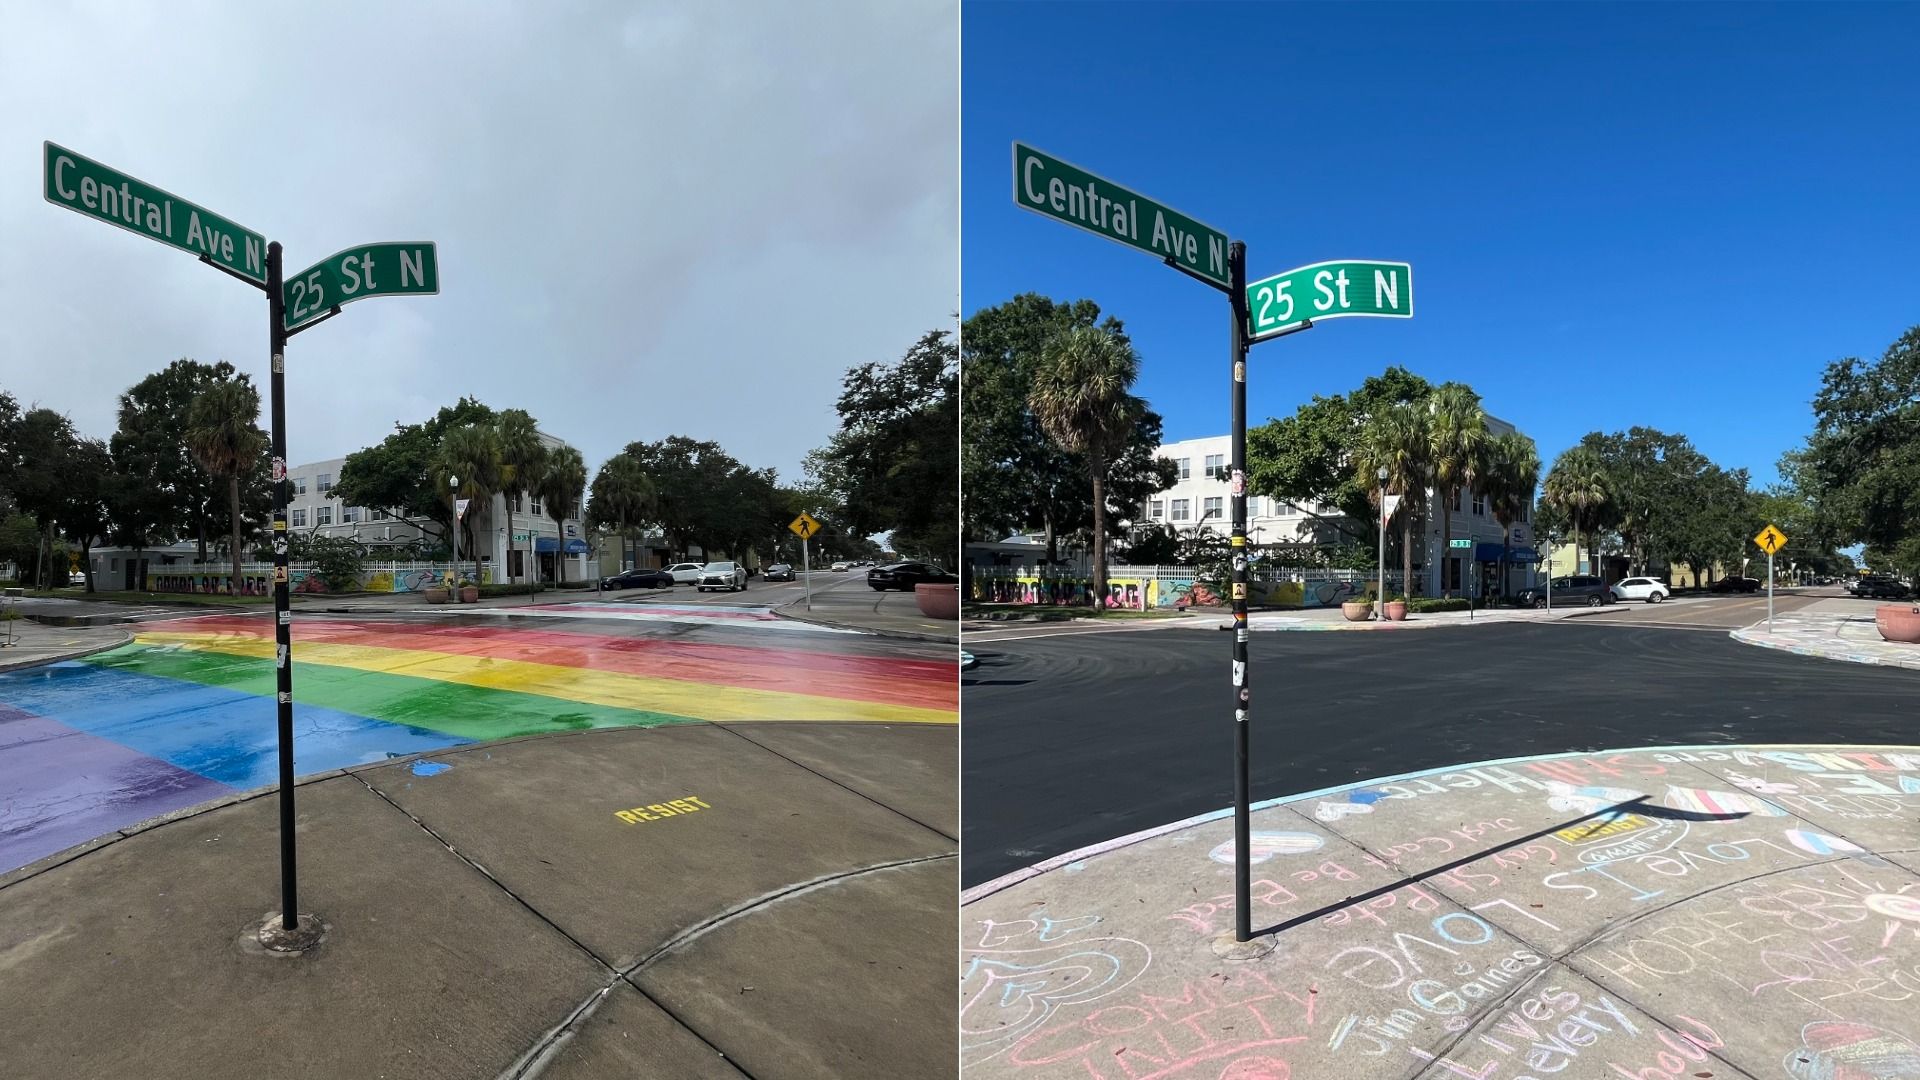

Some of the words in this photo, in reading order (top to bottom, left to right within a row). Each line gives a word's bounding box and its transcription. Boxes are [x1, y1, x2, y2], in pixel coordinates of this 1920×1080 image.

[54, 154, 172, 238] Central
[186, 210, 233, 263] Ave
[244, 235, 260, 274] N
[1023, 154, 1138, 241] Central
[1151, 210, 1198, 264] Ave
[1208, 234, 1224, 276] N
[291, 269, 324, 320] 25
[340, 250, 376, 295] St
[400, 249, 424, 288] N
[1256, 279, 1294, 328] 25
[1313, 268, 1351, 311] St
[1374, 269, 1399, 310] N
[613, 796, 712, 825] RESIST
[1379, 766, 1548, 800] Here
